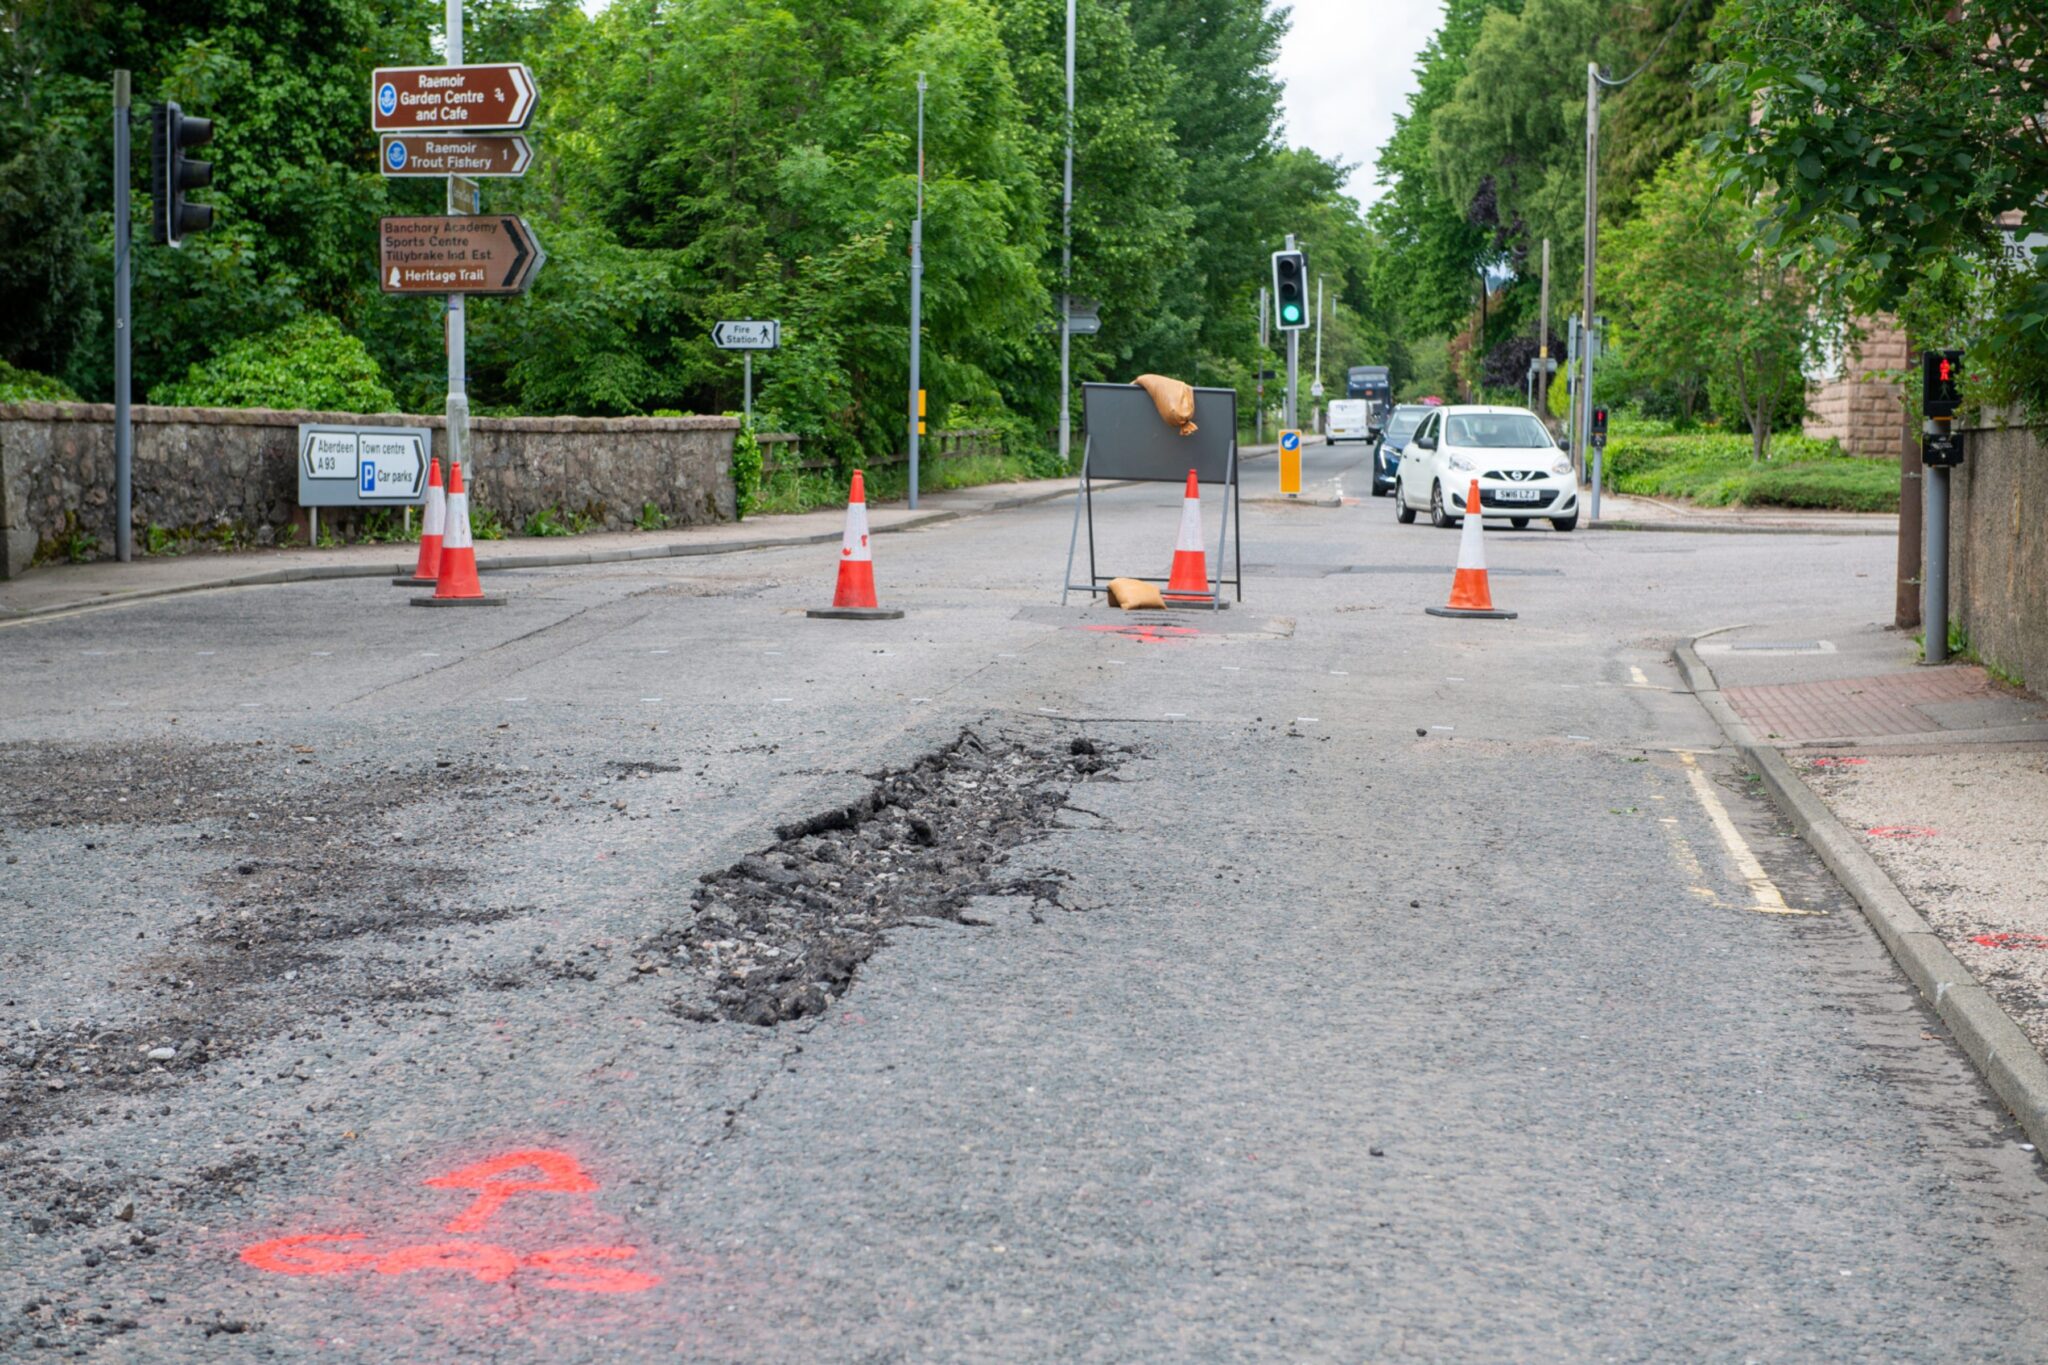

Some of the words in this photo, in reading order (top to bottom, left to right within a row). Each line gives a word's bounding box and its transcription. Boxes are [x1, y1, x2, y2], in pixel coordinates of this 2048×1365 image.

[419, 74, 465, 88] Raemoir
[400, 90, 441, 105] Garden
[445, 90, 484, 103] Centre
[416, 107, 437, 121] and
[440, 106, 468, 120] Cafe
[426, 141, 477, 153] Raemoir
[410, 156, 443, 168] Trout
[447, 157, 492, 170] Fishery
[502, 149, 508, 160] 1
[385, 223, 440, 234] Banchory
[444, 222, 498, 234] Academy
[385, 236, 424, 248] Sports
[429, 236, 469, 247] Centre
[385, 250, 444, 262] Tillybrake
[405, 270, 456, 283] Heritage
[459, 269, 484, 281] Trail
[734, 325, 750, 334] Fire
[726, 335, 758, 344] Station
[318, 439, 354, 454] Aberdeen
[361, 441, 381, 455] Town
[383, 442, 405, 455] centre
[364, 465, 373, 488] P
[377, 469, 391, 482] Car
[392, 469, 413, 484] parks
